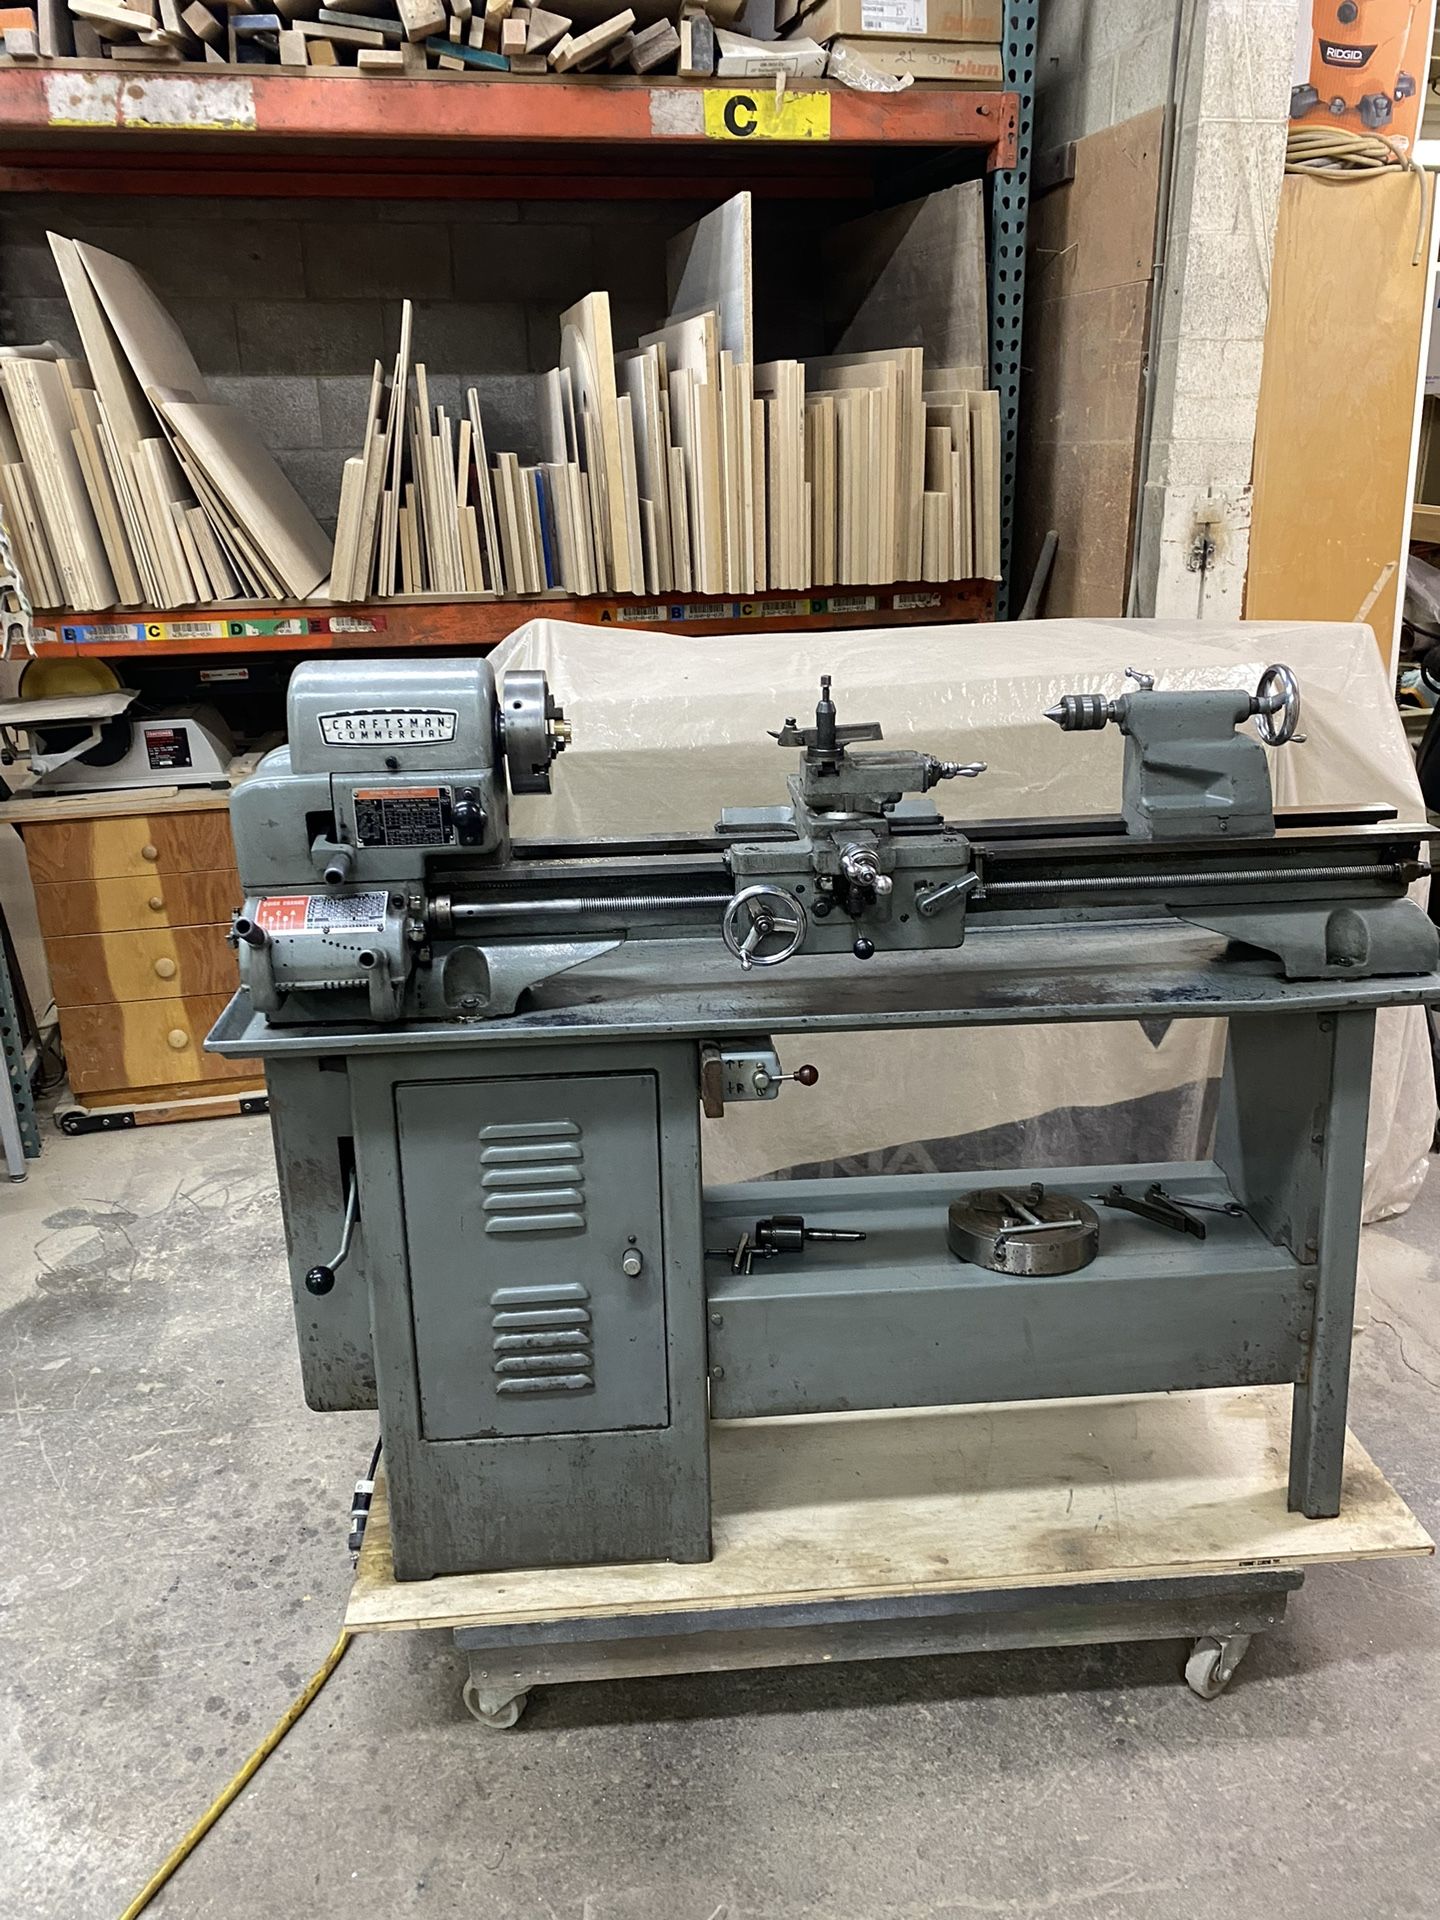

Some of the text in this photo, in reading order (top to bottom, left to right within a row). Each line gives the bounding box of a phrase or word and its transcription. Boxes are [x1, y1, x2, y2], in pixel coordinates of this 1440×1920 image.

[1326, 47, 1363, 60] RIDGID
[953, 60, 999, 77] blum
[724, 95, 757, 137] C
[601, 610, 612, 622] A
[671, 607, 682, 619] B
[742, 604, 753, 616] C
[64, 628, 76, 641] B
[148, 625, 160, 638] C
[231, 623, 243, 635] D
[332, 717, 445, 730] CRAFTSMAN
[337, 729, 443, 740] COMMERCIAL
